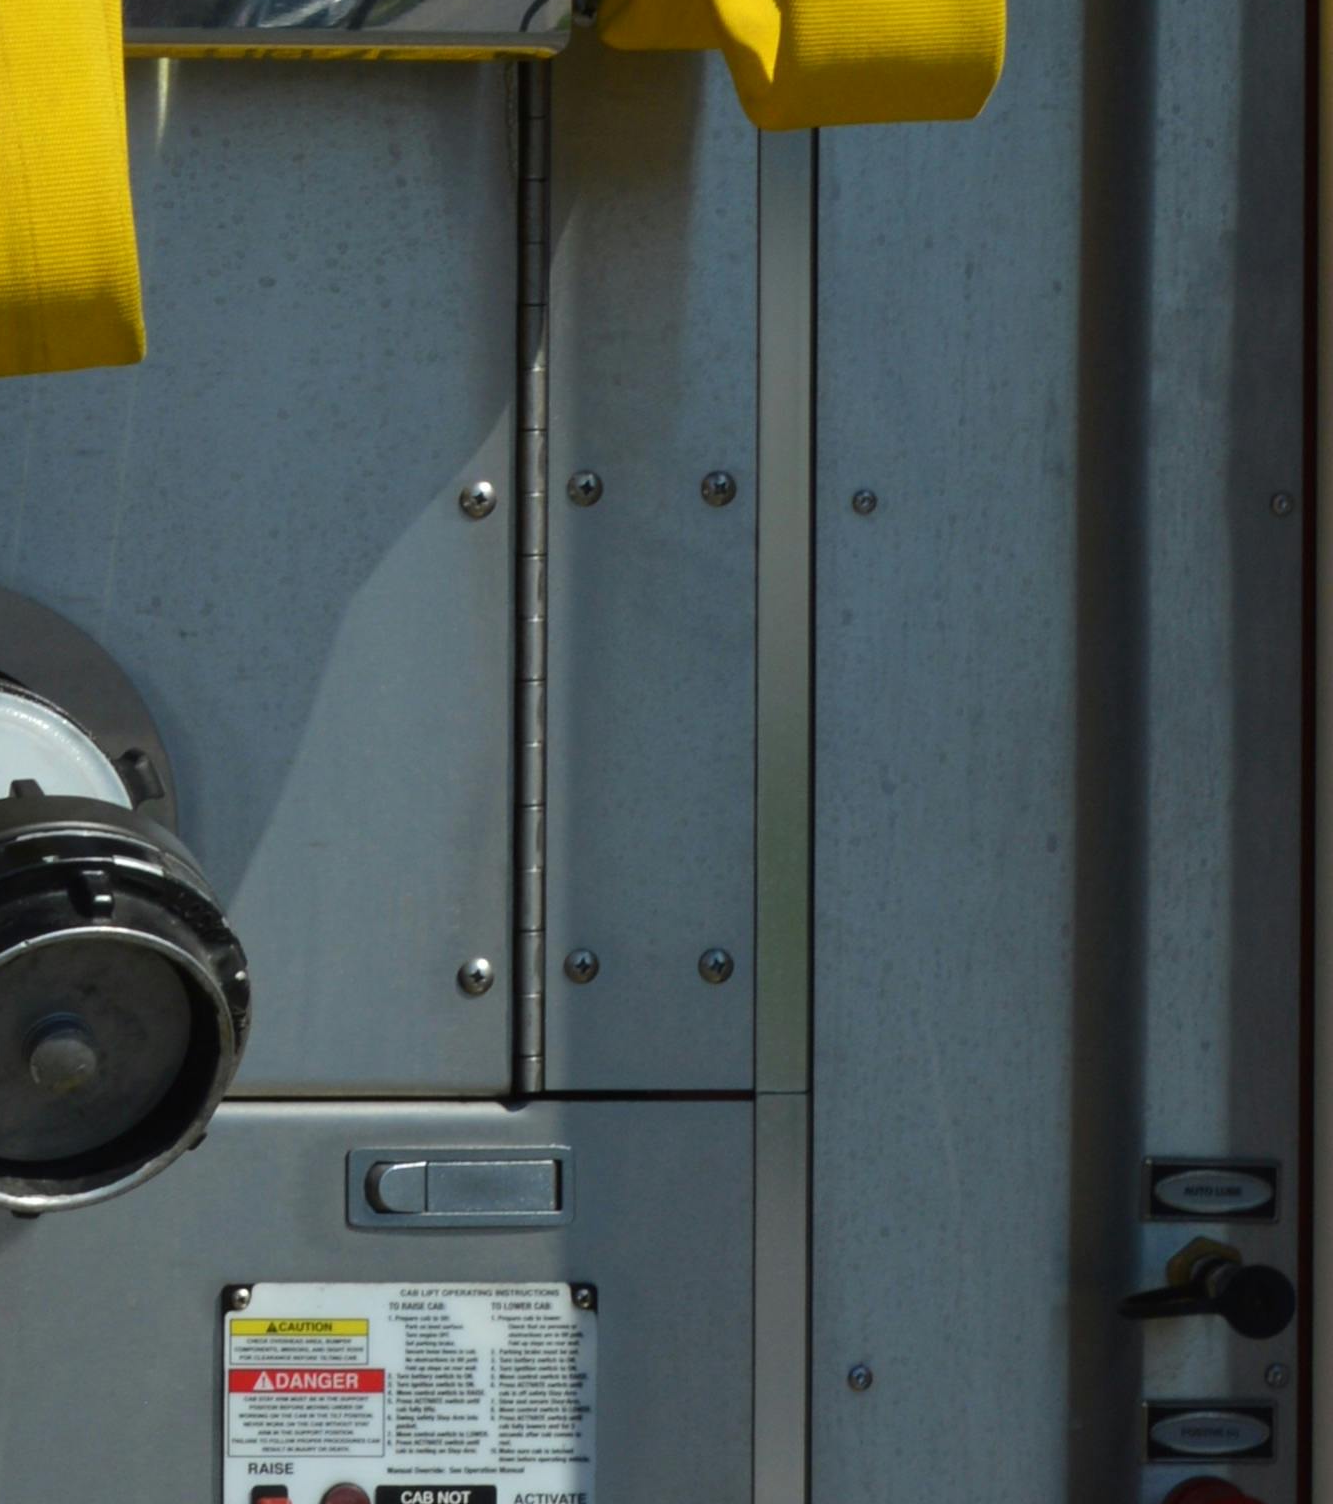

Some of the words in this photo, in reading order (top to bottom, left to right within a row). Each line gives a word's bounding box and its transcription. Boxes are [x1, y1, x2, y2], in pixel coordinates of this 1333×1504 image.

[441, 1289, 493, 1297] OPERATING
[495, 1289, 560, 1297] INSTRUCTIONS
[278, 1322, 333, 1332] CAUTION
[276, 1372, 359, 1389] DANGER
[248, 1462, 294, 1475] RAISE
